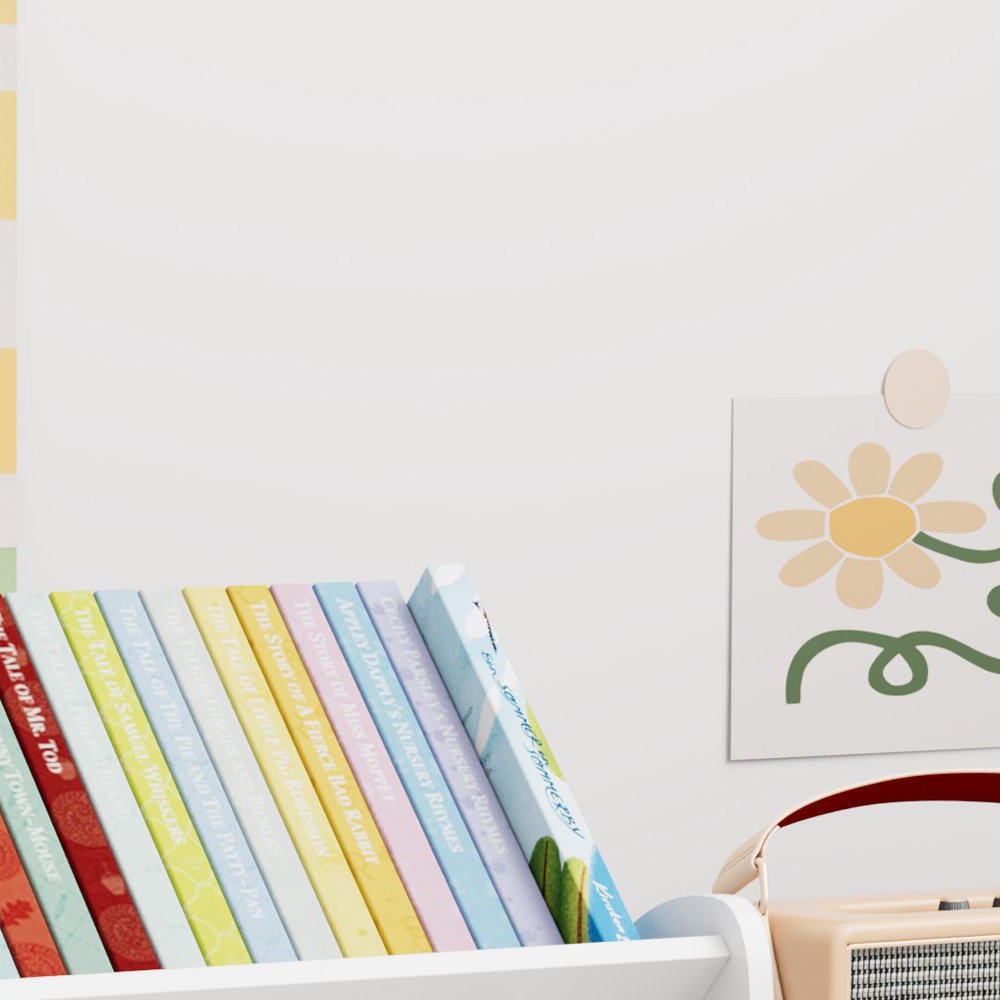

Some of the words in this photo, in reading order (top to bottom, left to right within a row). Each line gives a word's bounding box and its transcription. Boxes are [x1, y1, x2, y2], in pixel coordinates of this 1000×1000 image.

[251, 601, 273, 631] THE
[264, 632, 295, 679] STORY
[14, 683, 35, 705] OF
[286, 681, 305, 702] OF
[295, 600, 318, 629] THE
[308, 631, 340, 678] STORY
[330, 679, 349, 700] OF
[340, 702, 367, 740] MISS
[358, 741, 395, 802] MOPPET
[23, 706, 49, 737] MR.
[75, 606, 97, 638] THE
[89, 638, 114, 678] TALE
[104, 678, 124, 700] OF
[114, 701, 150, 760] SAMUEL
[141, 763, 186, 845] WHISKERS
[296, 703, 316, 717] A
[38, 738, 65, 774] TOD
[304, 718, 336, 771] FIERCE
[328, 774, 352, 807] BAD
[343, 808, 378, 864] RABBIT
